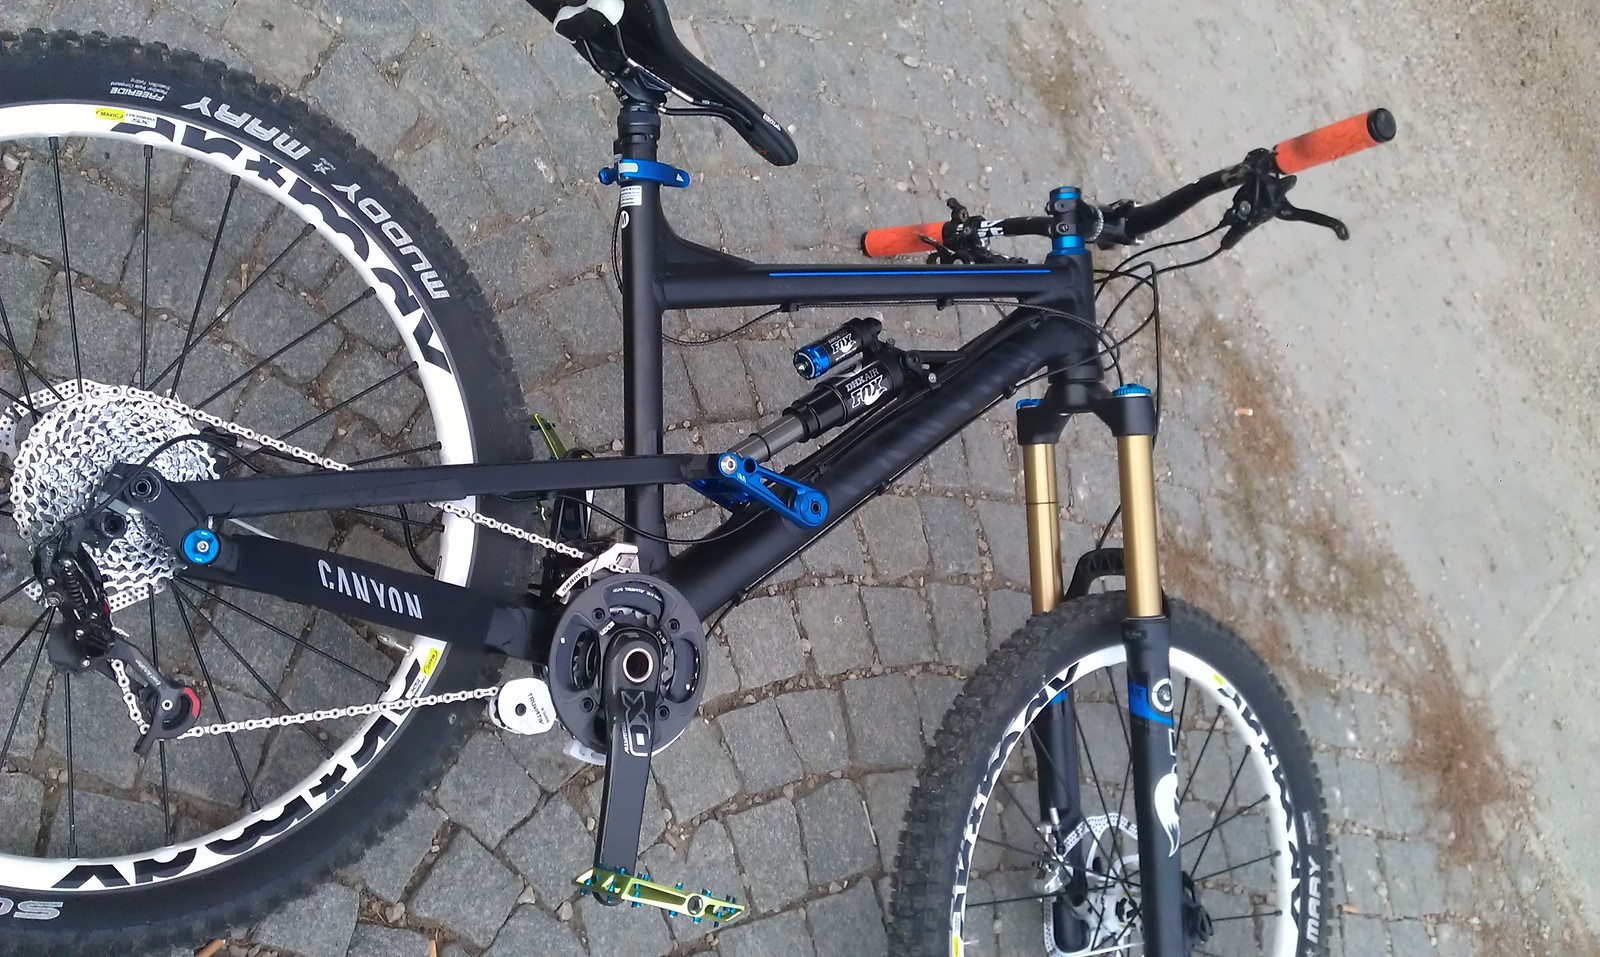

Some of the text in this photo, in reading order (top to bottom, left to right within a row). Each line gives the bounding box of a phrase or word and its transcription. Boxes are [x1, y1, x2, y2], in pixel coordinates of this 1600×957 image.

[109, 86, 165, 101] FREERIDE
[181, 96, 450, 300] MUDDY MARY
[831, 333, 856, 355] FOX
[852, 374, 888, 409] FOX
[317, 559, 424, 620] CANYON
[1306, 855, 1321, 944] MARY
